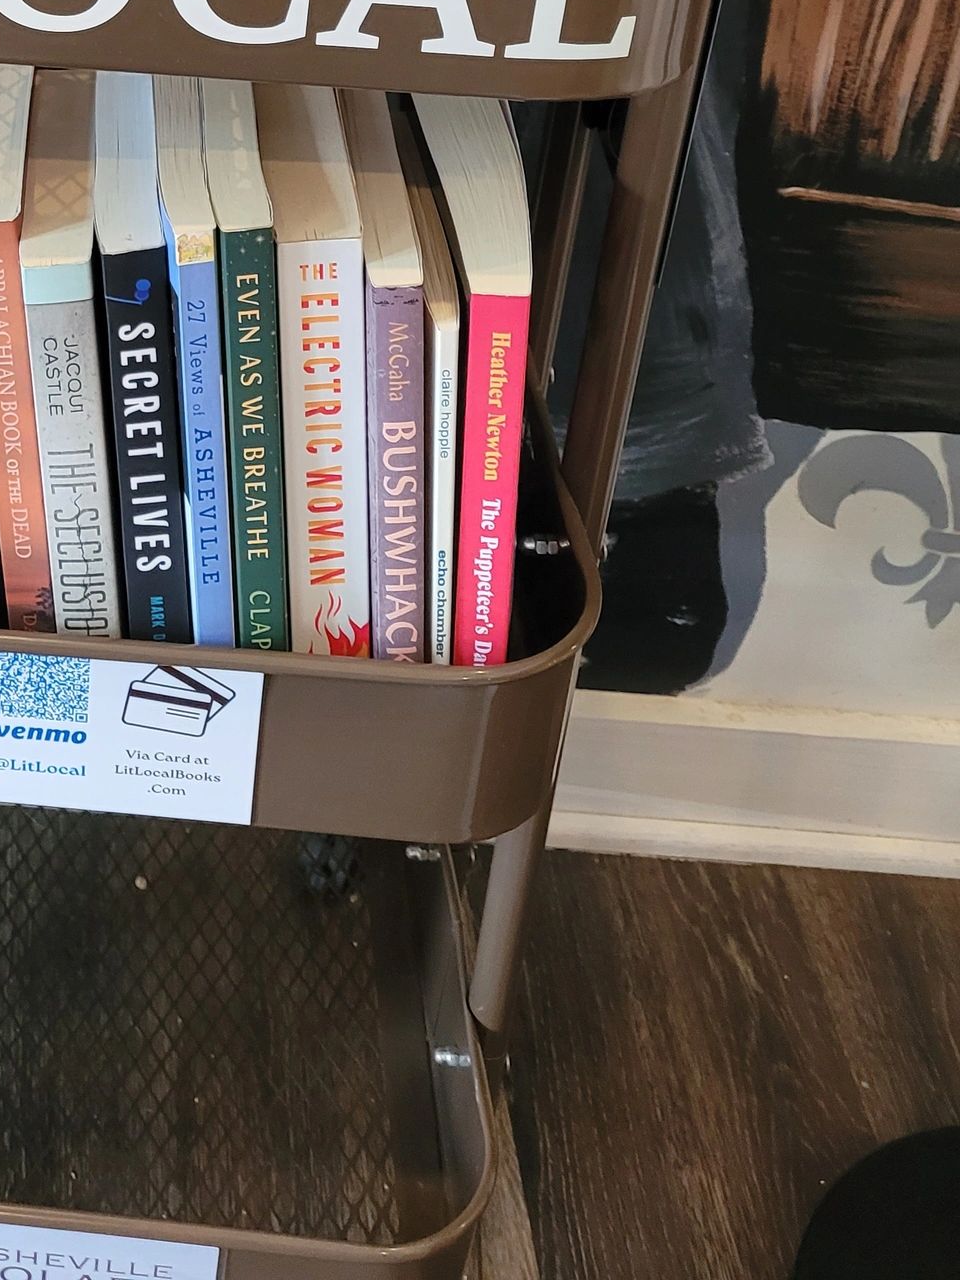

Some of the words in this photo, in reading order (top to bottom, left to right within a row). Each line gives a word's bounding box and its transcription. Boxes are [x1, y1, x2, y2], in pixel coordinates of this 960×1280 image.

[299, 262, 339, 282] THE
[186, 300, 207, 323] 27
[235, 273, 262, 345] EVEN
[43, 336, 64, 417] CASTLE
[63, 337, 84, 414] JACQUI
[117, 321, 164, 458] SECRET
[189, 334, 208, 395] Views
[238, 354, 263, 388] AS
[301, 292, 344, 455] ELECTRIC
[388, 321, 411, 403] McGaha
[441, 368, 452, 409] claire
[488, 331, 512, 408] Heather
[0, 397, 23, 456] BOOK
[192, 403, 205, 417] of
[240, 395, 266, 438] WE
[438, 412, 452, 460] hopple
[6, 457, 19, 477] OF
[47, 443, 98, 496] THE
[483, 412, 506, 482] Newton
[7, 477, 23, 505] THE
[194, 427, 221, 585] ASHEVILLE
[242, 447, 270, 562] BREATHE
[480, 497, 502, 531] The
[9, 507, 33, 559] DEAD
[129, 473, 173, 572] LIVES
[305, 465, 346, 586] WOMAN
[437, 549, 448, 587] echo
[472, 535, 501, 635] Puppeteer's
[150, 595, 166, 628] MARK
[435, 589, 448, 658] chamber
[115, 764, 222, 783] LitLocalBooks
[125, 748, 151, 761] Via
[154, 751, 192, 765] Card
[195, 756, 210, 766] at
